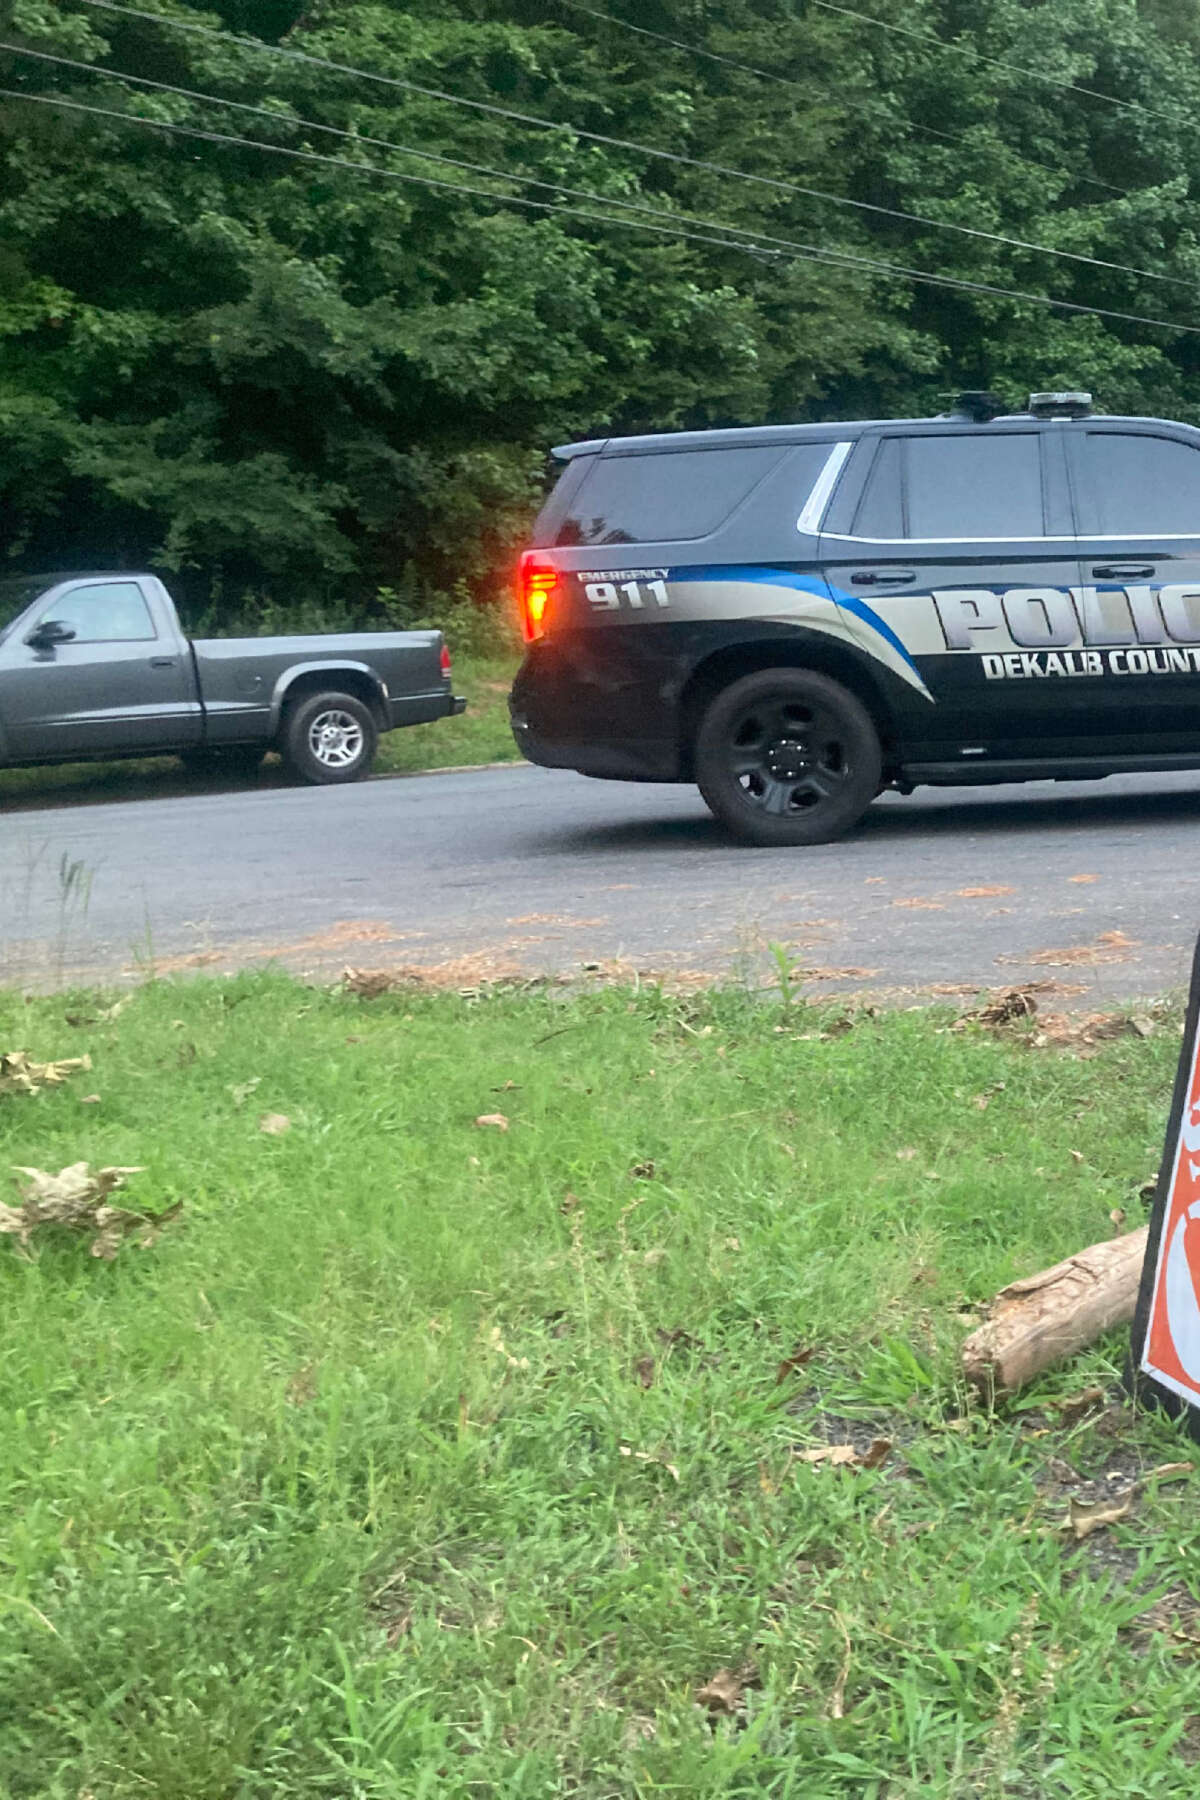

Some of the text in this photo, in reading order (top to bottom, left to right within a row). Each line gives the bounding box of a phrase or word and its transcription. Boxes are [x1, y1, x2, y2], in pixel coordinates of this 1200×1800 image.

[577, 568, 670, 582] EMERGENCY
[585, 580, 670, 610] 911
[981, 650, 1104, 680] DEKALB
